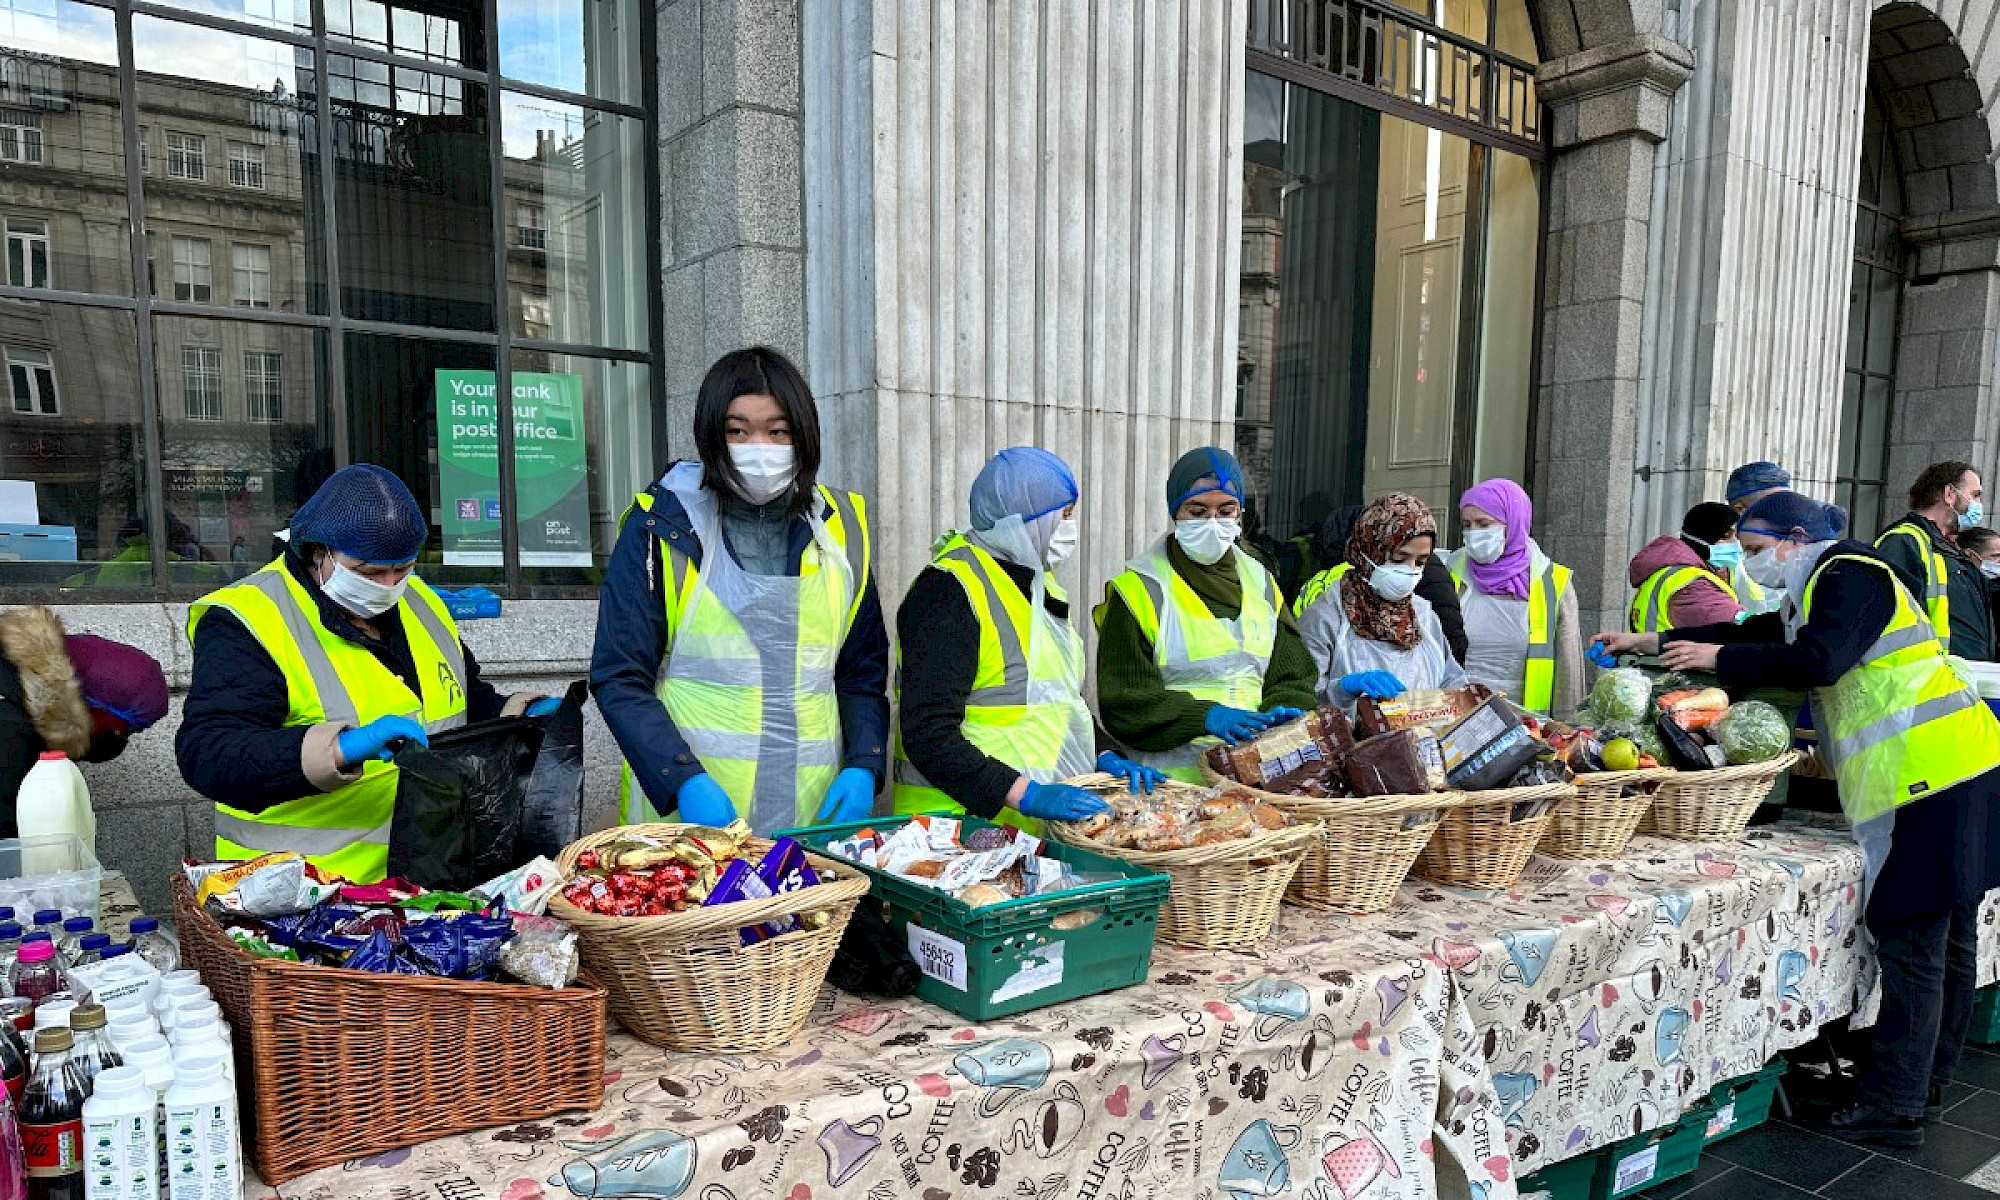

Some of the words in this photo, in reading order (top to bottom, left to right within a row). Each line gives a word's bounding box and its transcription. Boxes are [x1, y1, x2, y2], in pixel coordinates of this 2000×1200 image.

[450, 379, 497, 397] Your
[514, 383, 551, 399] ank
[471, 400, 489, 417] in
[453, 422, 498, 440] post
[514, 423, 558, 439] ffice
[546, 520, 561, 528] an
[546, 526, 571, 536] post
[1558, 1049, 1574, 1101] COFFEE
[1326, 1063, 1369, 1126] COFFEE
[915, 1098, 957, 1166] COFFEE
[1472, 1107, 1492, 1163] COFFEE
[1076, 1131, 1126, 1200] COFFEE
